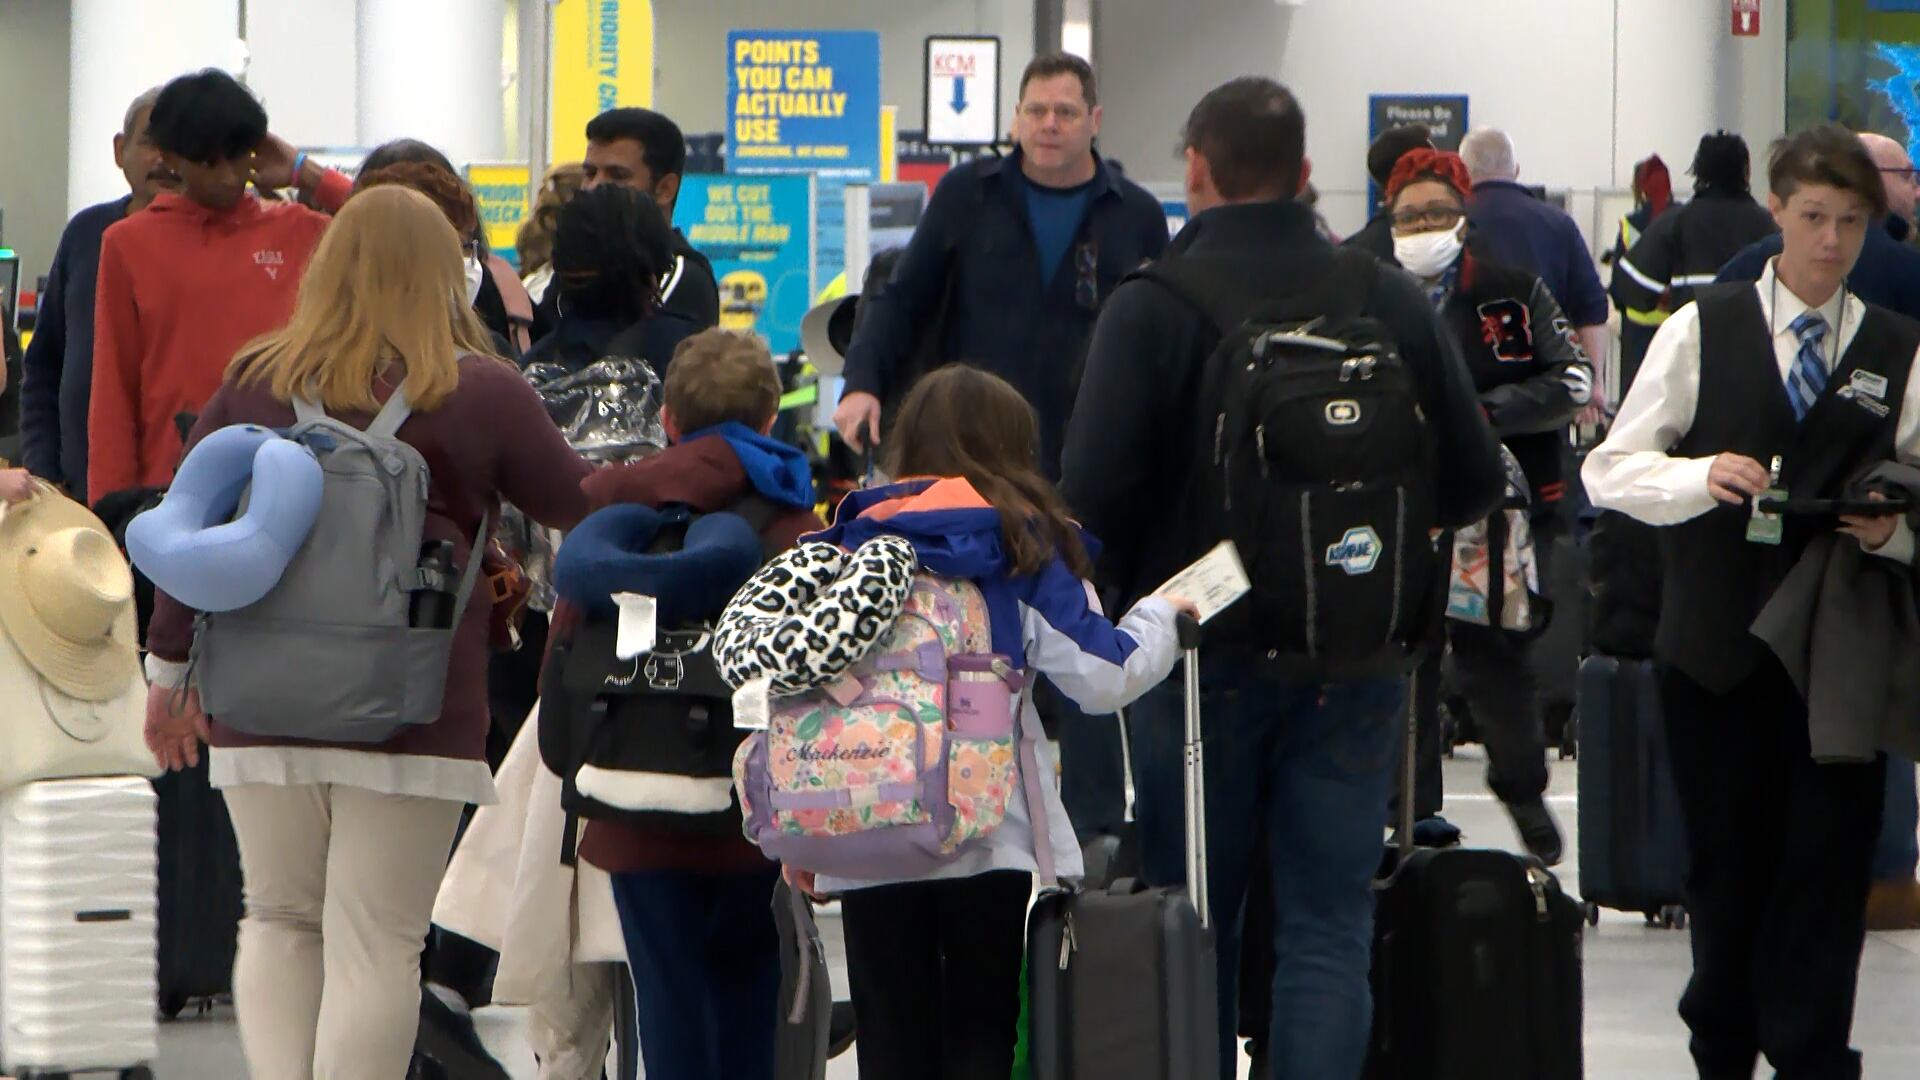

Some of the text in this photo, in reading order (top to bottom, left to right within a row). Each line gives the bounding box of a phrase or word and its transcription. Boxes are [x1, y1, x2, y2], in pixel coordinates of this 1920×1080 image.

[736, 39, 819, 64] POINTS
[934, 54, 976, 72] KCM
[736, 66, 832, 90] YOU CAN
[736, 92, 847, 117] ACTUALLY
[736, 119, 780, 143] USE
[707, 184, 770, 202] WE CUT
[704, 204, 772, 222] OUT THE
[786, 740, 891, 763] Mackenzie
